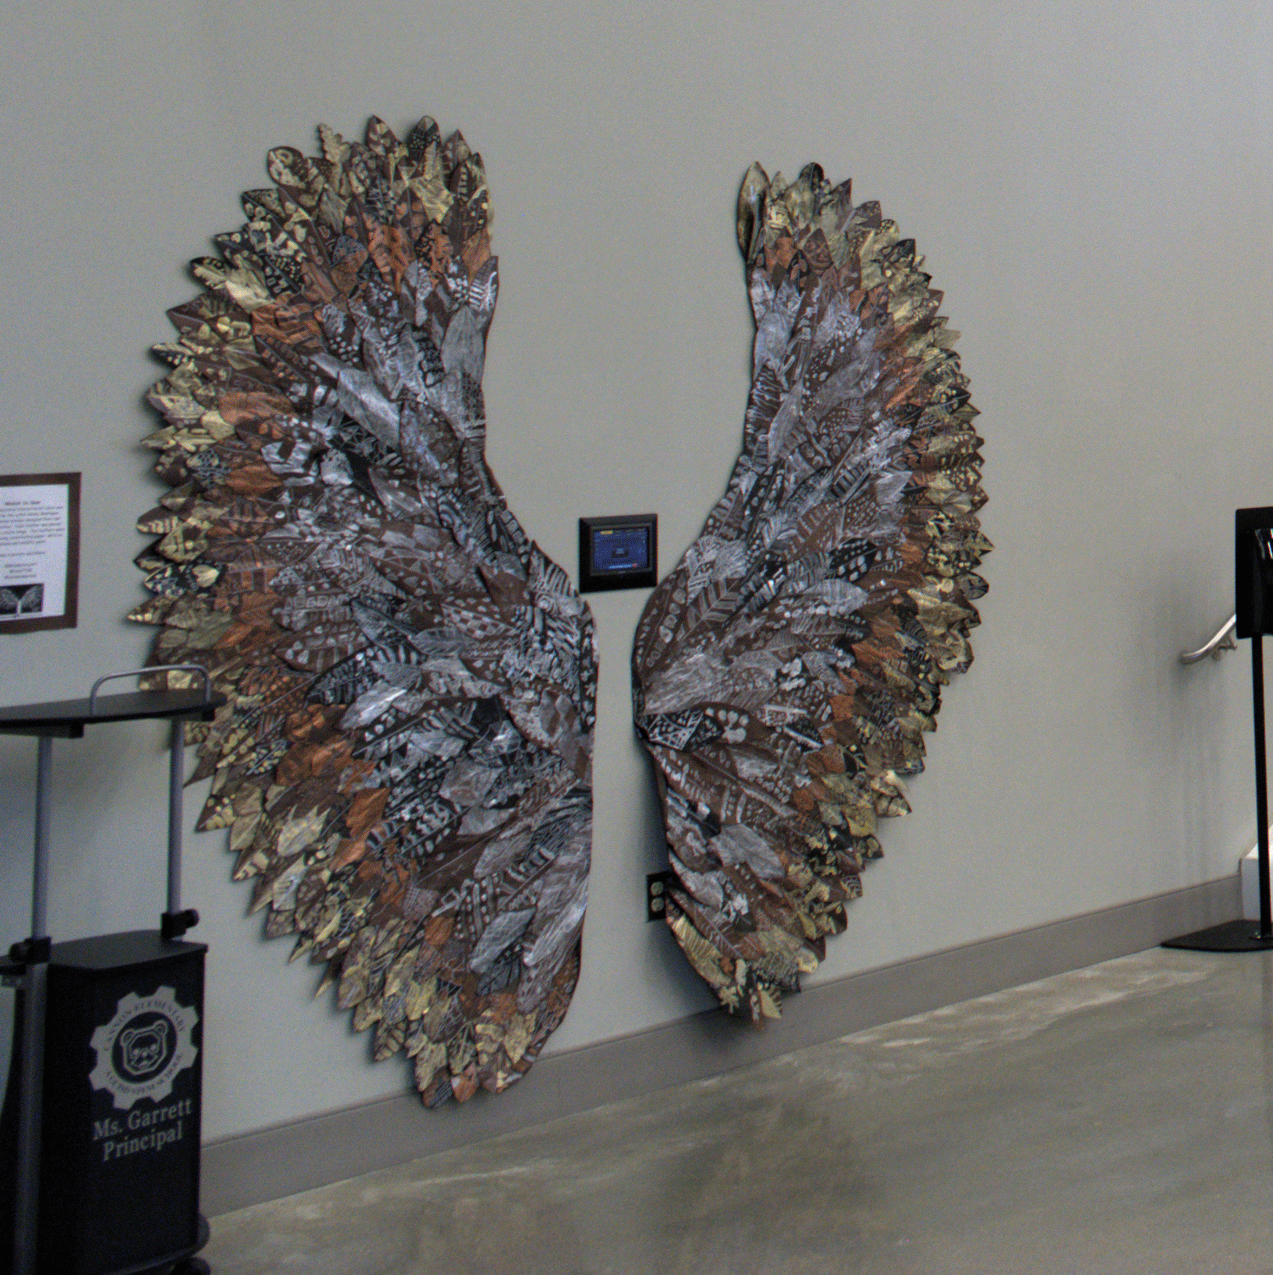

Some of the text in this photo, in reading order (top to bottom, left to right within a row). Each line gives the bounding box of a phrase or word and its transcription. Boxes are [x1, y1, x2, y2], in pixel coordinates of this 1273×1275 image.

[93, 1098, 192, 1141] Ms. Garrett
[103, 1119, 183, 1162] Principal
